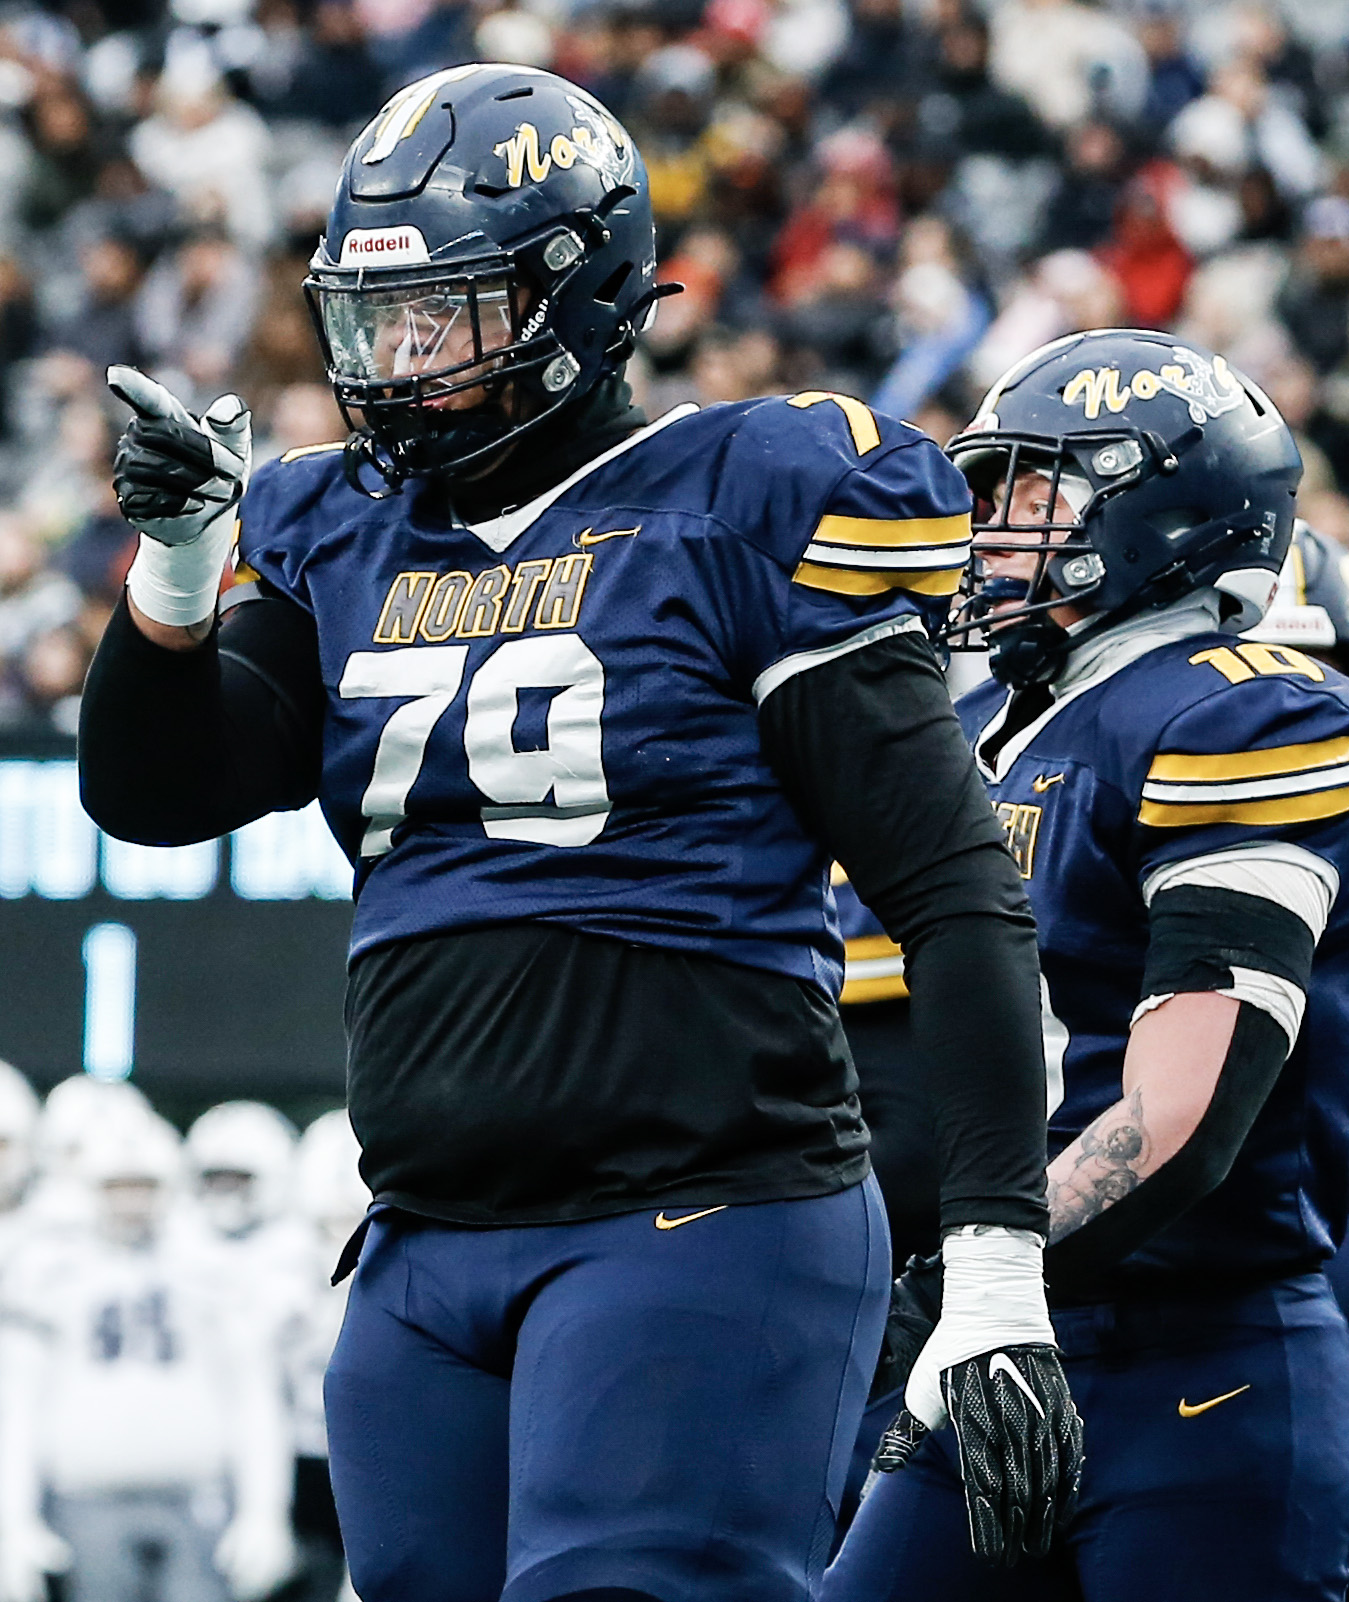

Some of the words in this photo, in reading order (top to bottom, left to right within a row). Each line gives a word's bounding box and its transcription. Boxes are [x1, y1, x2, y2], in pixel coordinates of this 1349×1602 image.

[349, 235, 410, 254] Riddell
[521, 298, 549, 342] ddell
[373, 554, 594, 643] NORTH
[340, 633, 614, 858] 79
